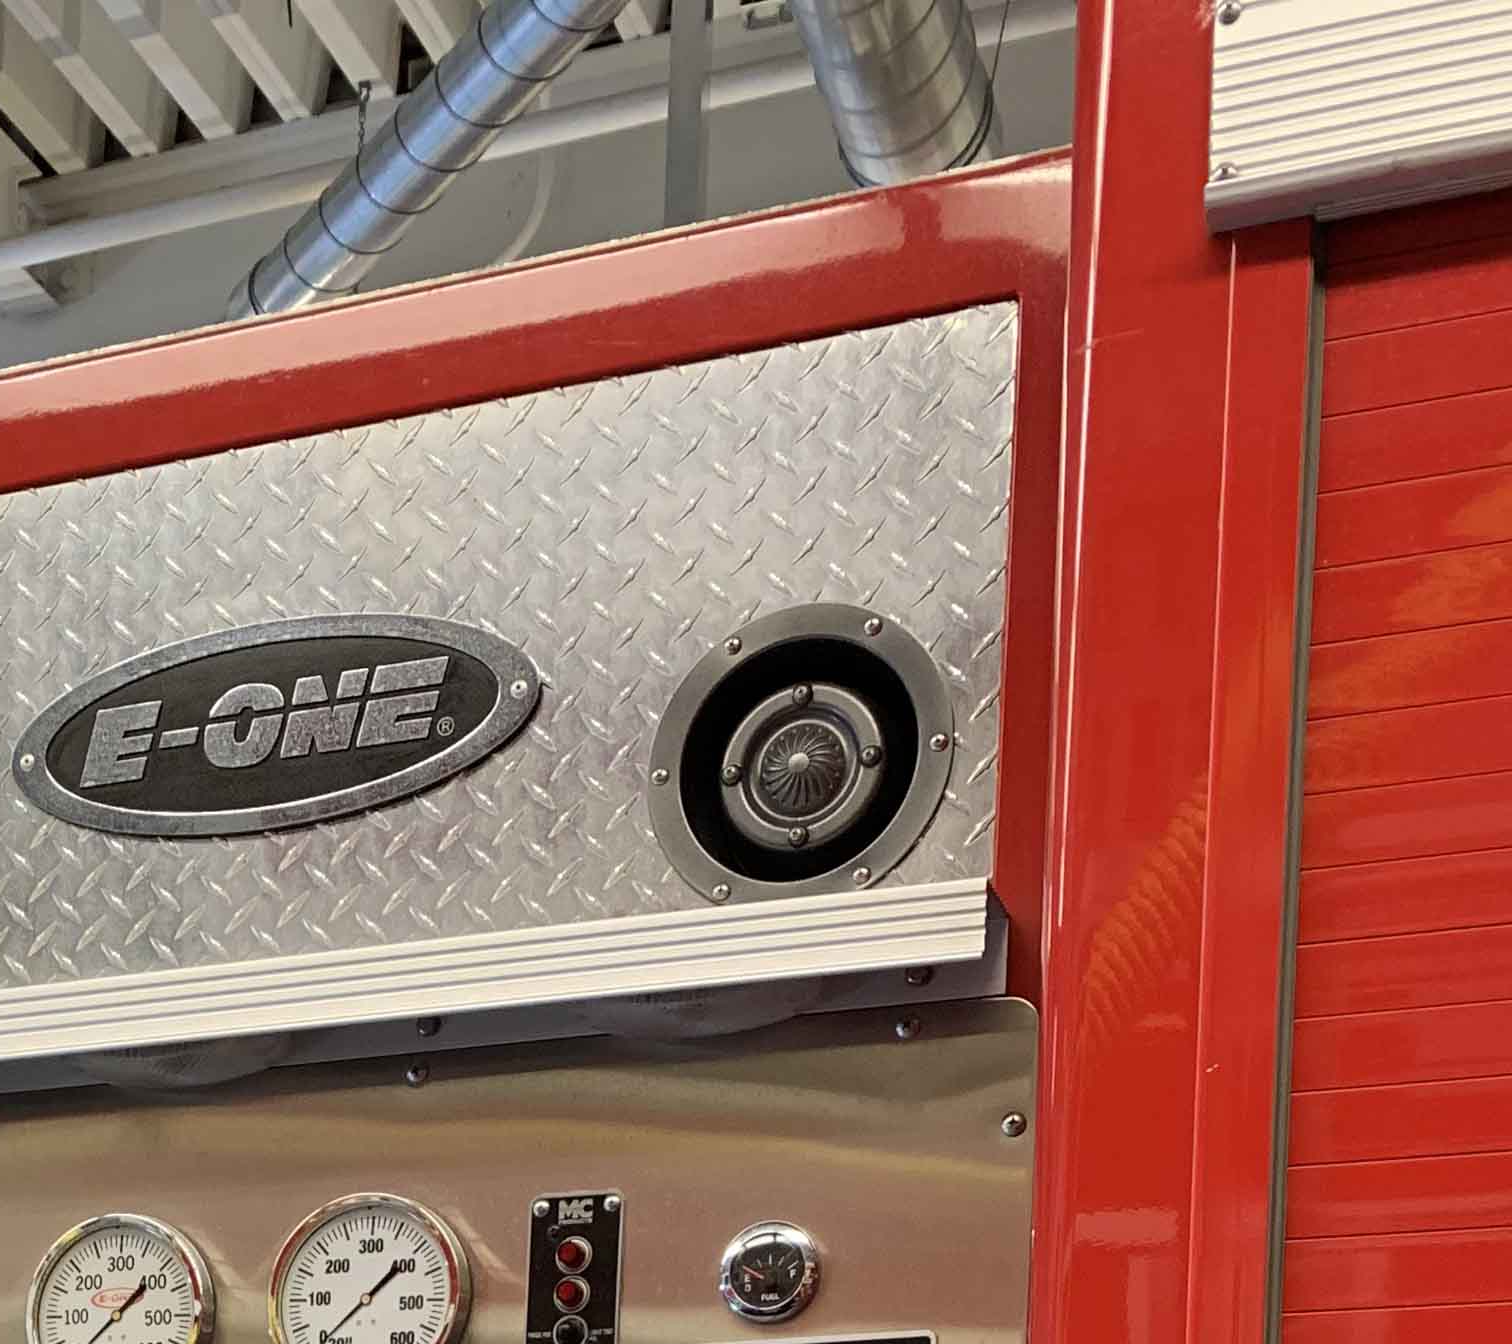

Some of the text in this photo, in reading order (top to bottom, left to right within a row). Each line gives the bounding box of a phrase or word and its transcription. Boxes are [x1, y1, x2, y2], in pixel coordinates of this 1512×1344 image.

[80, 655, 450, 789] E-ONE
[559, 1199, 593, 1219] MC
[359, 1238, 383, 1254] 300
[108, 1256, 134, 1272] 300
[326, 1259, 349, 1274] 200
[76, 1274, 102, 1291] 200
[140, 1274, 167, 1290] 400
[309, 1292, 331, 1306] 100
[400, 1295, 423, 1310] 500
[761, 1293, 780, 1302] FUEL
[65, 1309, 88, 1325] 100
[145, 1309, 172, 1326] 500
[320, 1330, 327, 1344] 0
